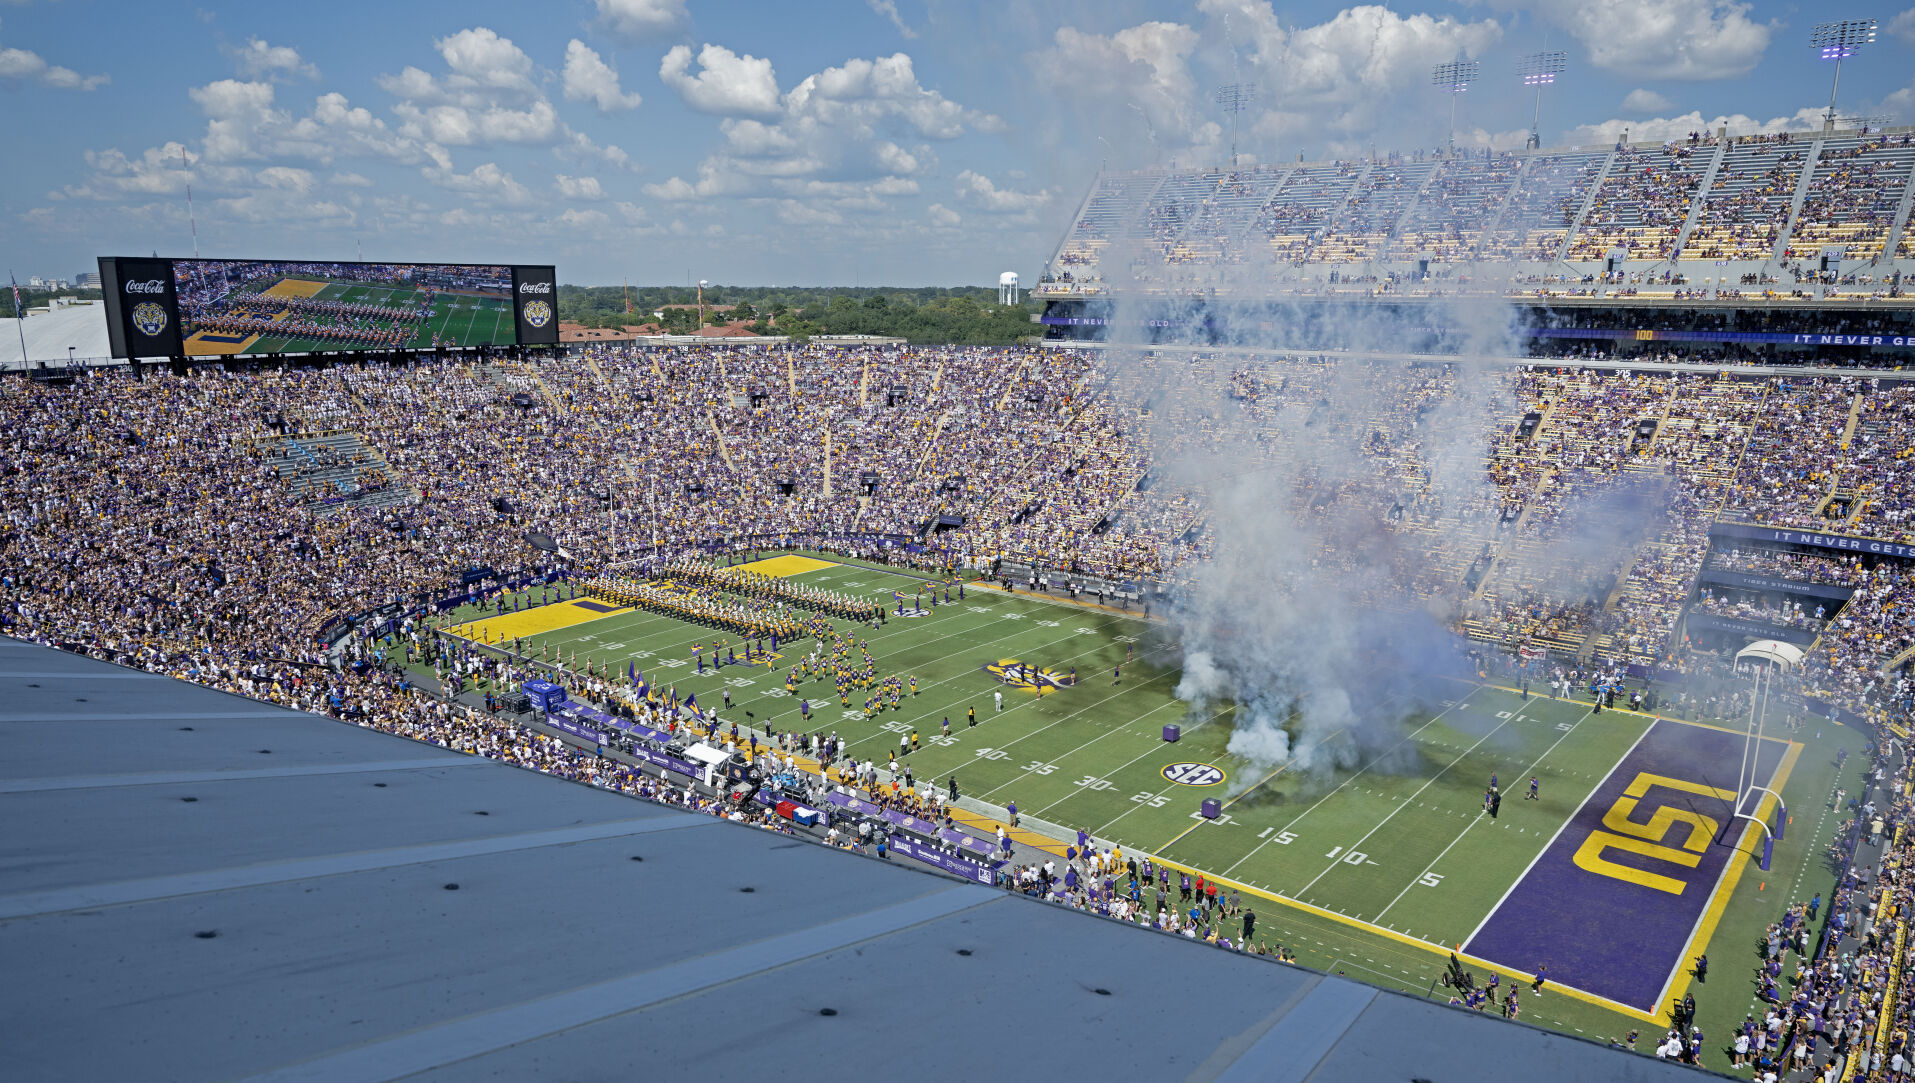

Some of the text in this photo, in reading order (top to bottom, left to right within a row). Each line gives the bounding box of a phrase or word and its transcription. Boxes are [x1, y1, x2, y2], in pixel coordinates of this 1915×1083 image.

[1636, 330, 1653, 340] 100
[1794, 335, 1915, 346] IT NEVER GE
[1775, 531, 1915, 557] IT NEVER GETS
[880, 720, 914, 733] 50
[928, 735, 960, 747] 45
[976, 747, 1008, 761] 40
[1020, 761, 1060, 776] 35
[1165, 763, 1221, 785] SEC
[1073, 775, 1113, 791] 30
[1129, 791, 1172, 808] 25
[1257, 826, 1298, 845] 15
[1572, 772, 1738, 896] LSU
[1325, 846, 1368, 866] 10
[1418, 871, 1445, 888] 5
